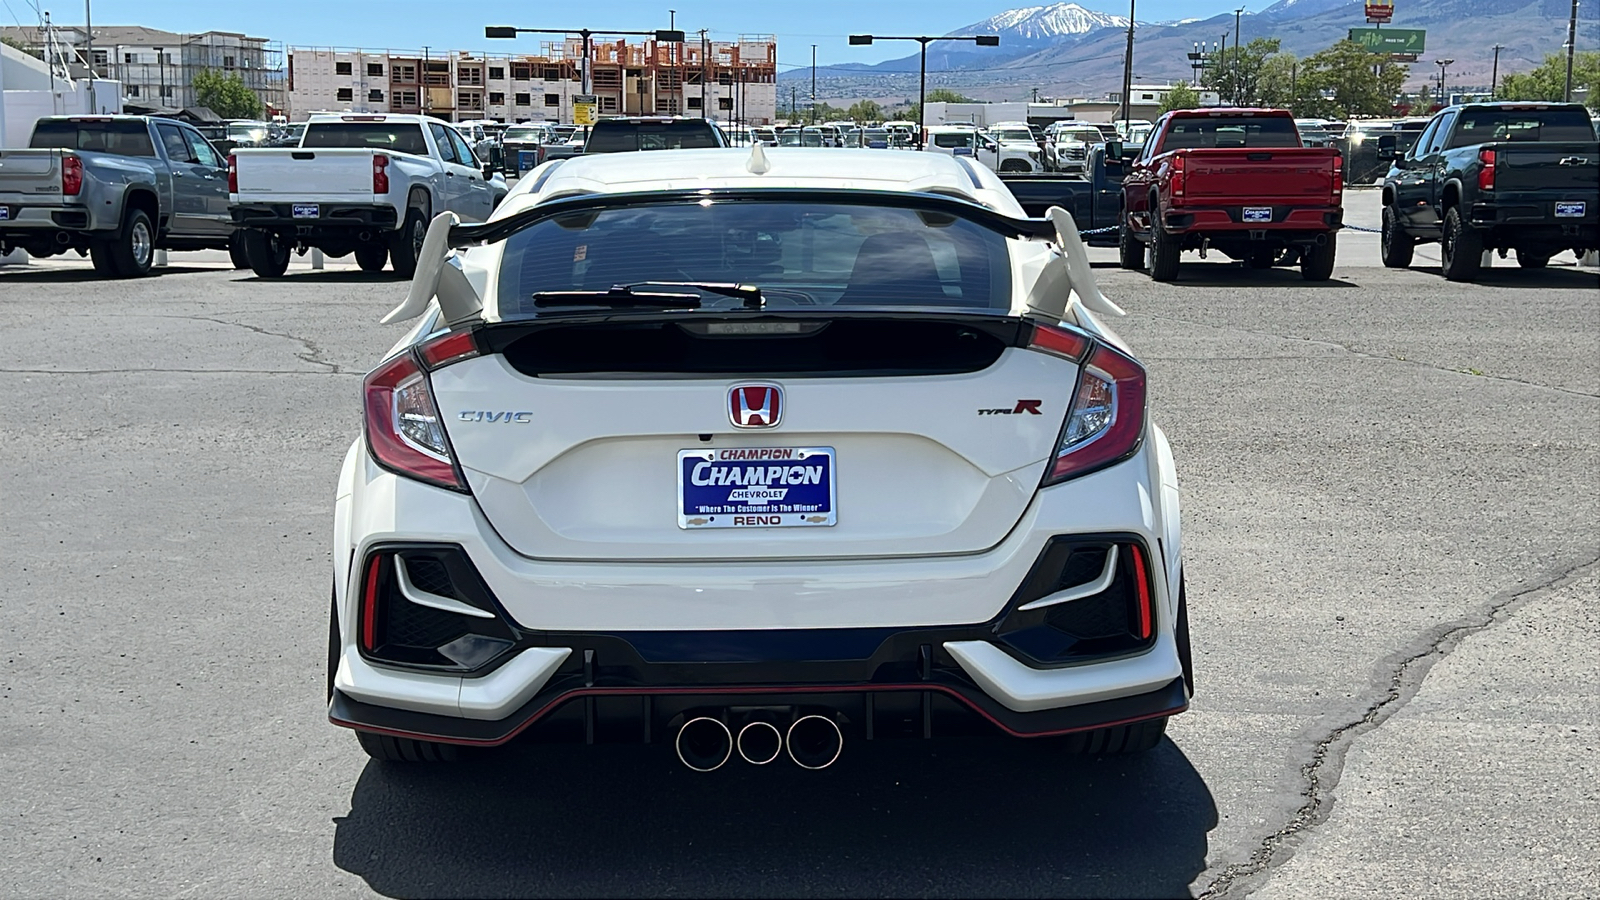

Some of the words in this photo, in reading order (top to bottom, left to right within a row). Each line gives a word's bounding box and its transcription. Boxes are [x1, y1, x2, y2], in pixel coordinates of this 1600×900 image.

[1012, 399, 1042, 415] R
[457, 410, 533, 423] CIVIC
[720, 448, 793, 460] CHAMPION
[691, 461, 823, 486] CHAMPION
[731, 490, 784, 499] CHEVROLET
[723, 505, 736, 513] The
[737, 504, 770, 513] Customer
[771, 504, 778, 512] Is
[779, 504, 792, 512] The
[733, 515, 782, 526] RENO
